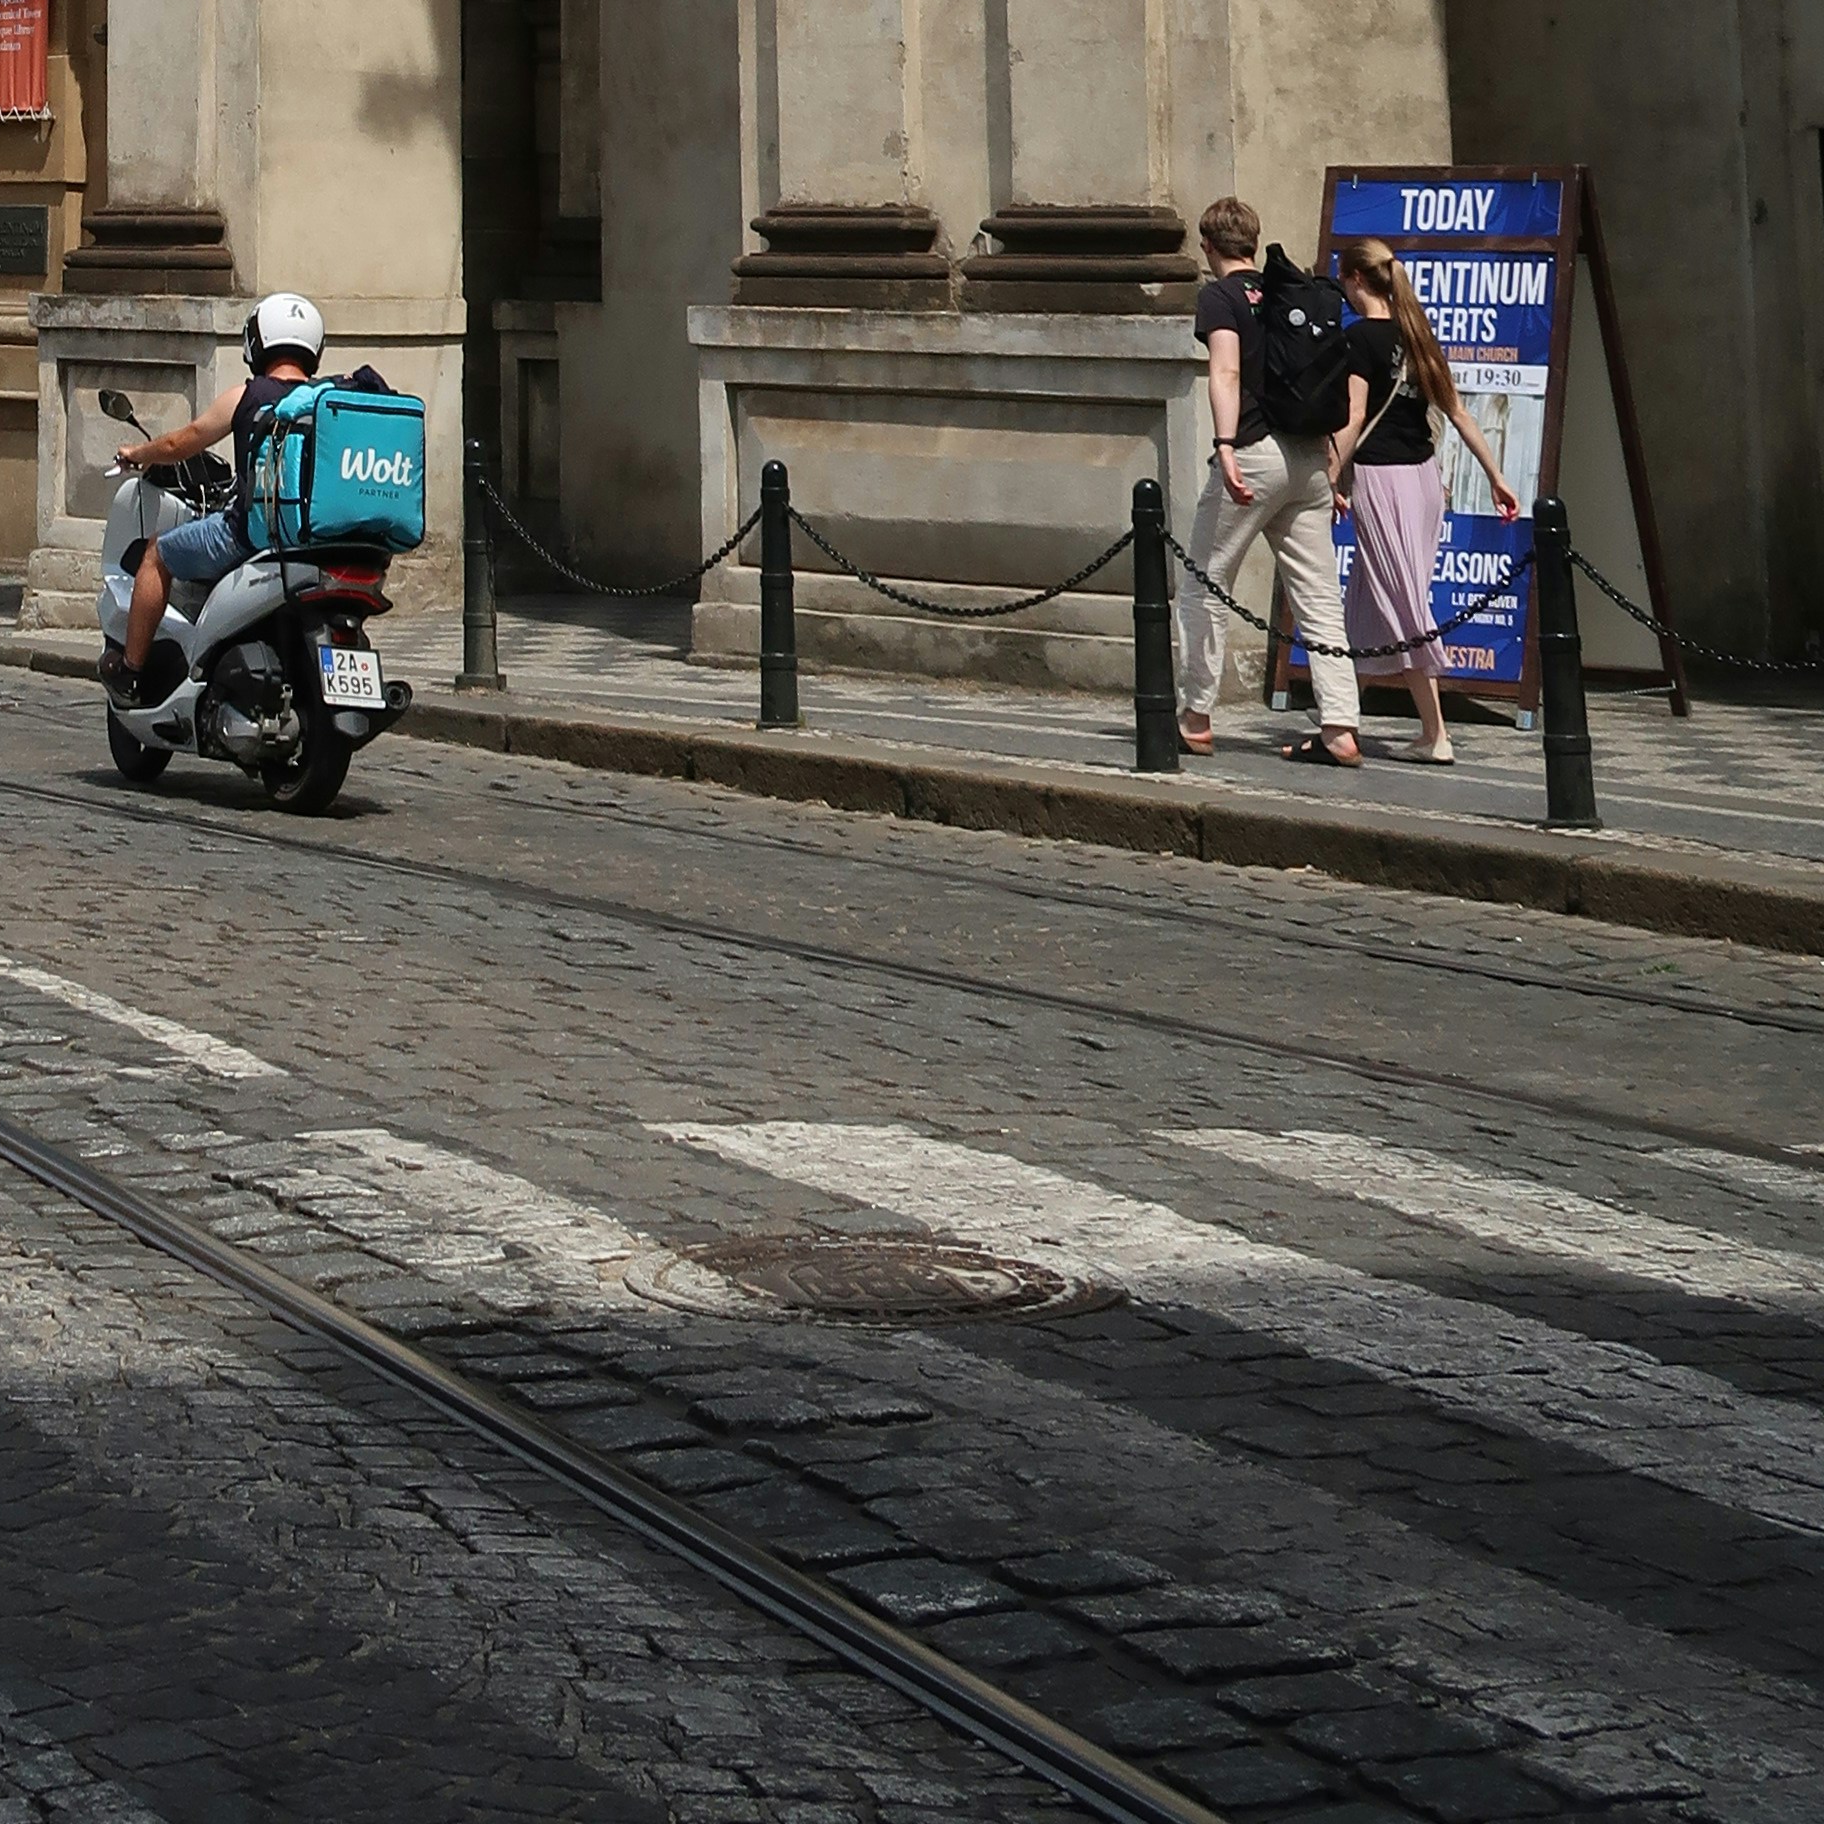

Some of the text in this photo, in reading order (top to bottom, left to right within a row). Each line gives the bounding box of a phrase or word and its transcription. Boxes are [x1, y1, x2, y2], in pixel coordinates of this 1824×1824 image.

[1400, 188, 1495, 231] TODAY
[1402, 261, 1548, 305] ENTINUM
[1447, 346, 1475, 361] MAIN
[1476, 346, 1518, 362] CHURCH
[1475, 368, 1521, 386] 19:30
[340, 447, 413, 486] Wolt
[358, 487, 400, 500] PARTNER
[335, 652, 357, 672] 2A
[326, 674, 373, 696] K595
